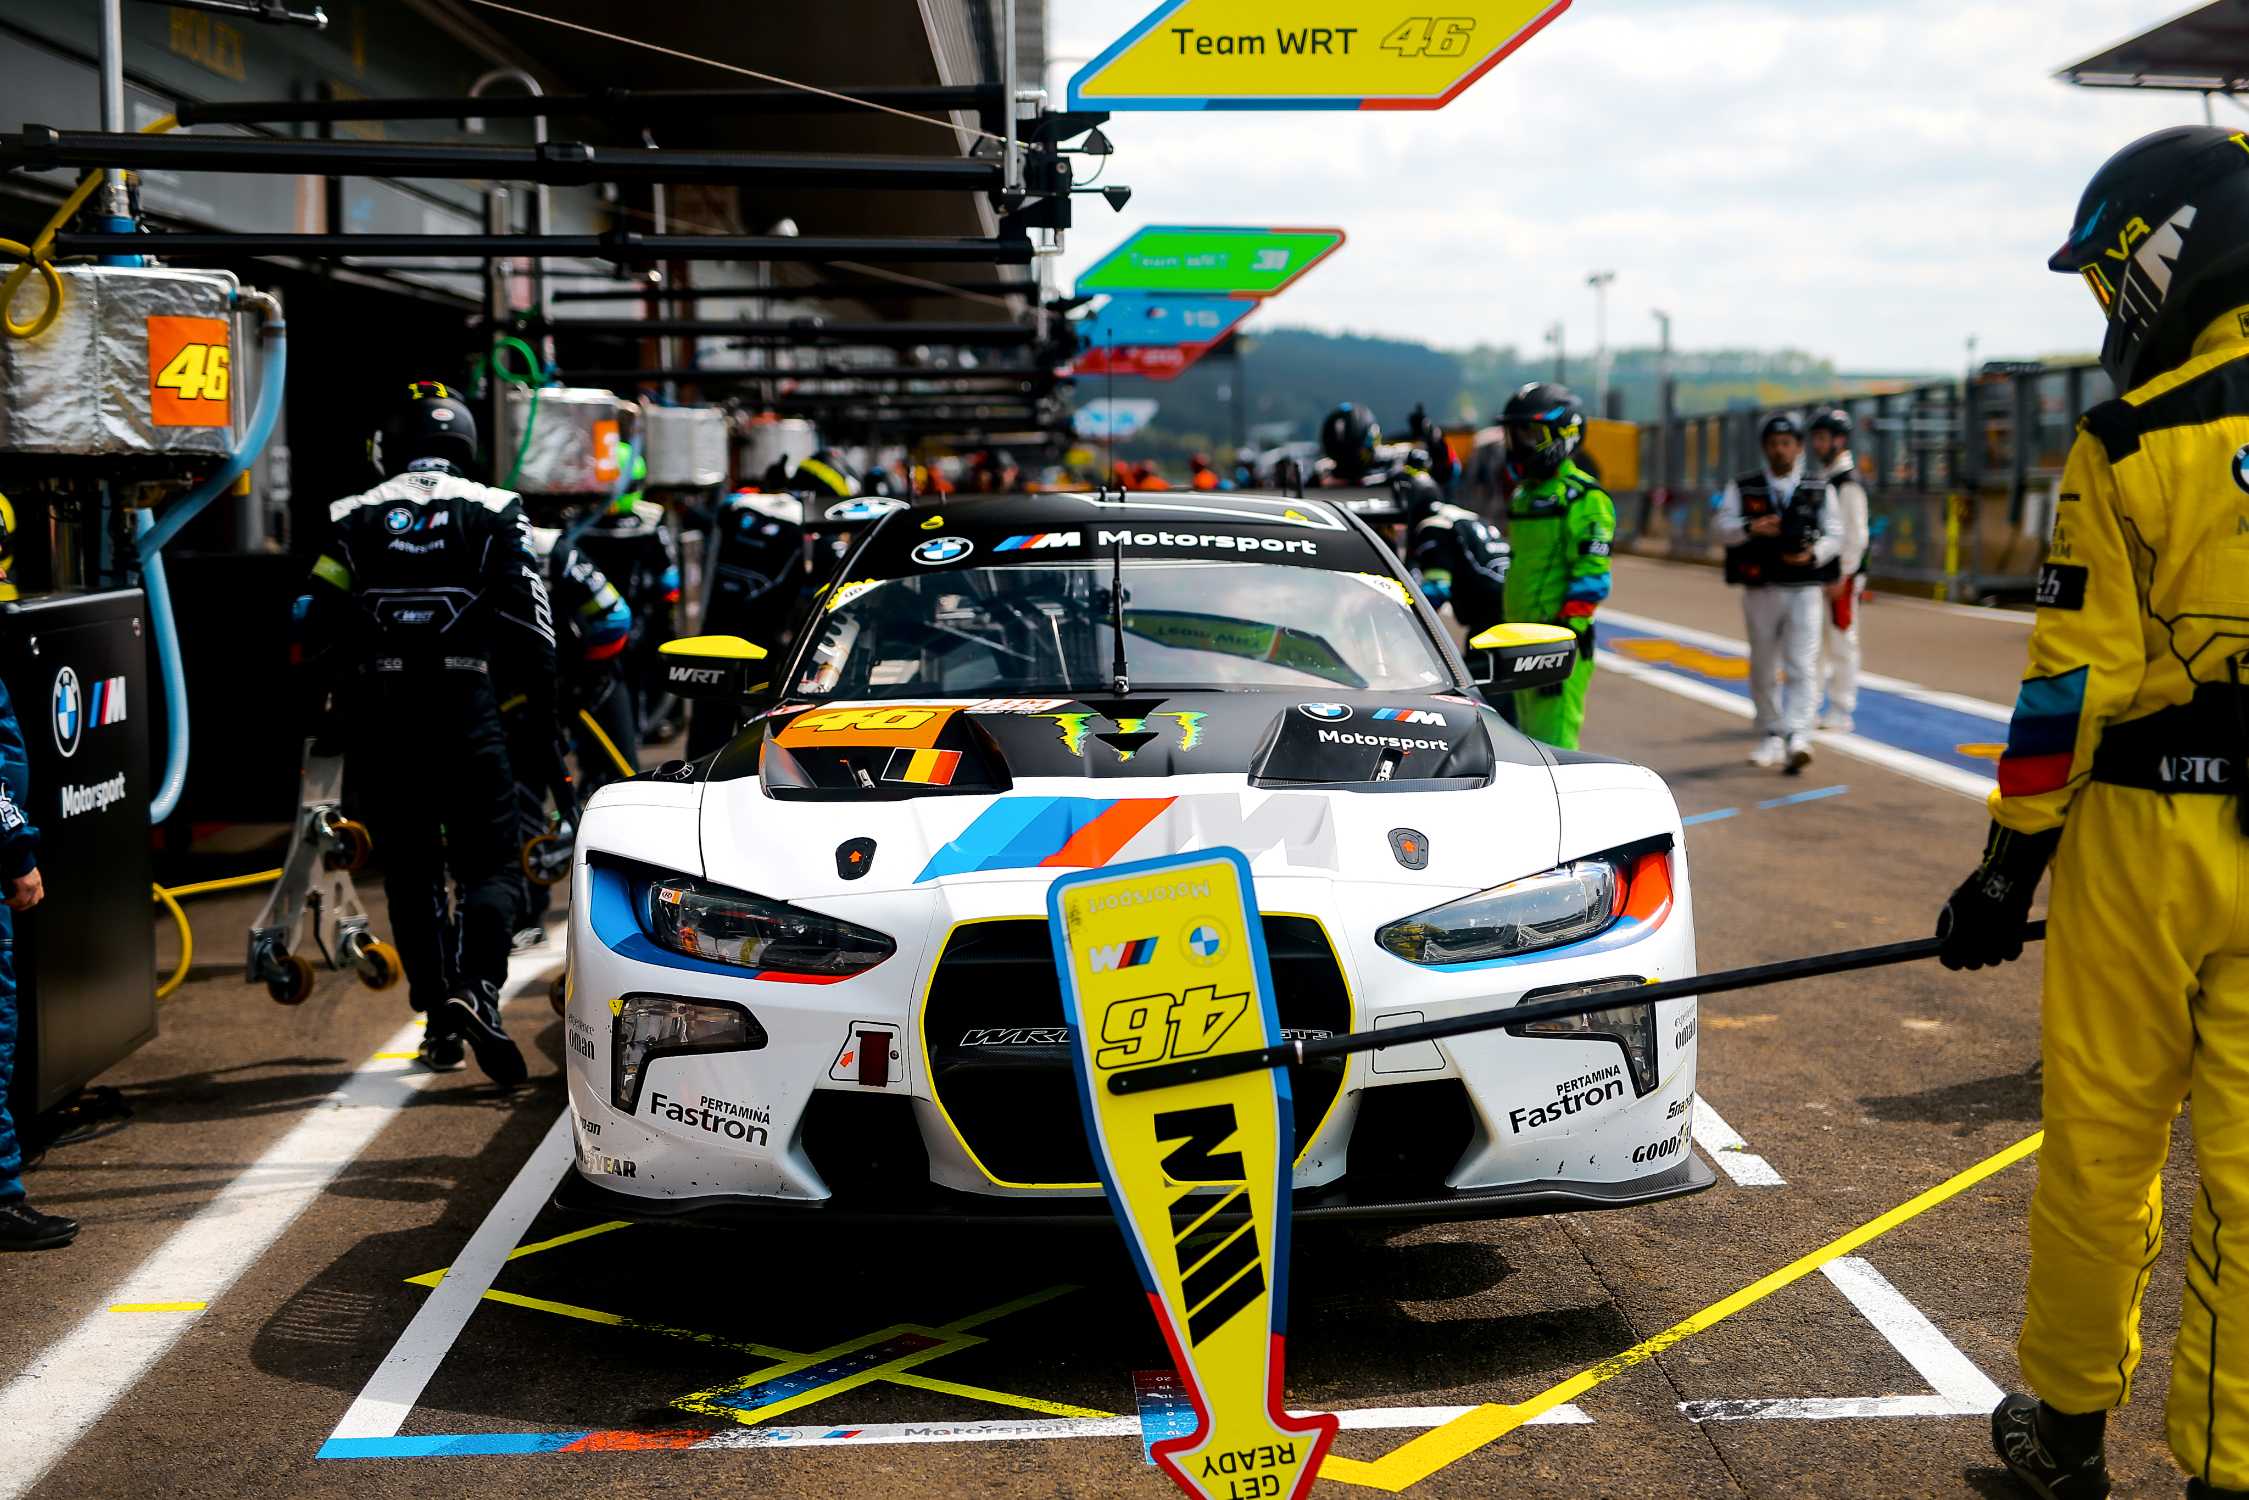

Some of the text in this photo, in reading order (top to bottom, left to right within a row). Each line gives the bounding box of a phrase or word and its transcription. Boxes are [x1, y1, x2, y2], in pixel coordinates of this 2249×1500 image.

[1171, 17, 1477, 57] Team WRT 46
[154, 342, 230, 401] 46
[1097, 529, 1318, 556] Motorsport
[668, 665, 725, 685] WRT
[1513, 651, 1570, 672] WRT
[1317, 729, 1449, 751] Motorsport
[61, 771, 127, 819] Motorsport
[1089, 879, 1210, 913] Motorsport
[1096, 984, 1250, 1070] 46
[568, 1028, 595, 1061] oman
[1556, 1064, 1620, 1096] PERTAMINA
[650, 1091, 768, 1147] Fastron
[700, 1095, 770, 1125] PERTAMINA
[1508, 1079, 1624, 1134] Fastron
[1202, 1442, 1296, 1478] READY
[1226, 1474, 1280, 1500] GET
